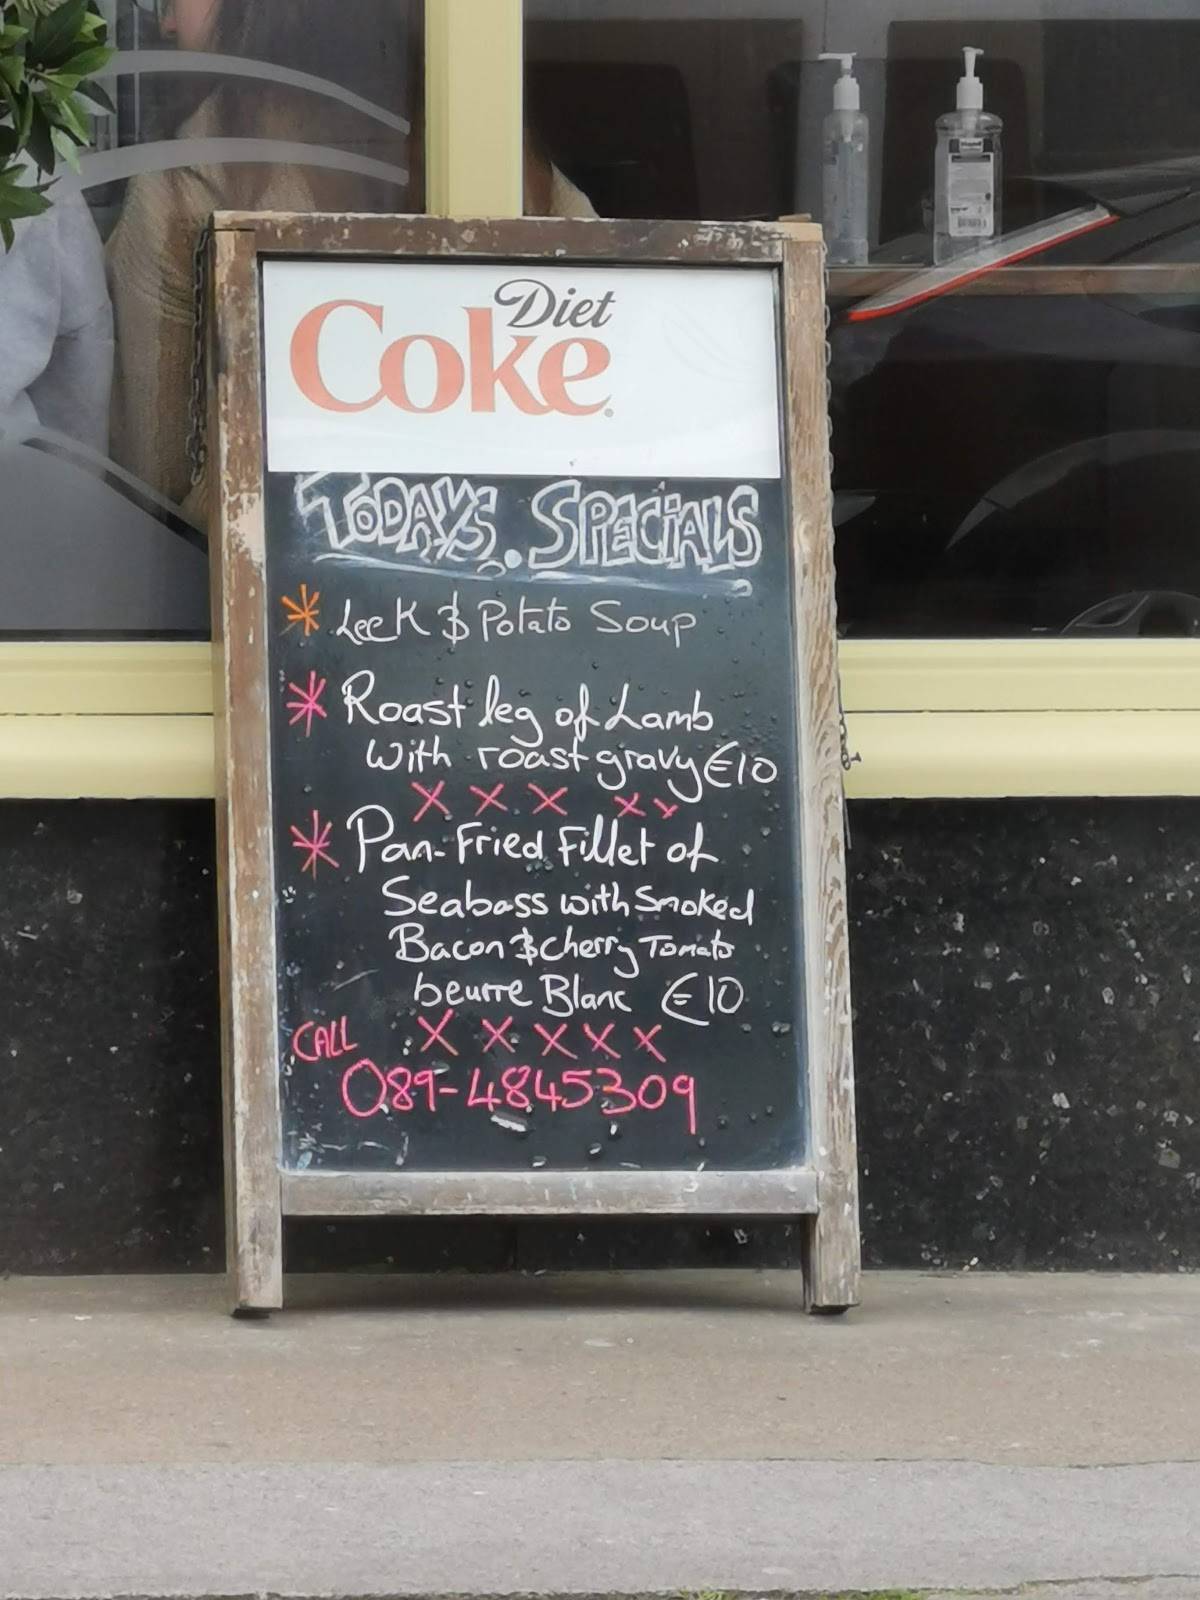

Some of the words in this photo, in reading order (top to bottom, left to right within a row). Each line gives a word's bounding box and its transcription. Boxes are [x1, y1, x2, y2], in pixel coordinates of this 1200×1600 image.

[494, 279, 616, 329] Diet
[289, 298, 613, 417] Coke
[477, 599, 572, 637] Potato
[589, 600, 698, 648] Soup
[341, 669, 467, 729] Roast
[554, 682, 601, 743] of
[477, 737, 591, 773] roast
[595, 746, 704, 804] gravy
[703, 740, 779, 788] €10
[664, 821, 721, 873] of
[381, 874, 550, 918] Seabass
[559, 882, 631, 918] with
[388, 921, 506, 964] Bacon
[638, 931, 736, 960] Tomato
[538, 972, 634, 1018] Blanc
[660, 972, 745, 1026] €10
[292, 1015, 359, 1062] CALL
[341, 1058, 697, 1136] 089-4845309
